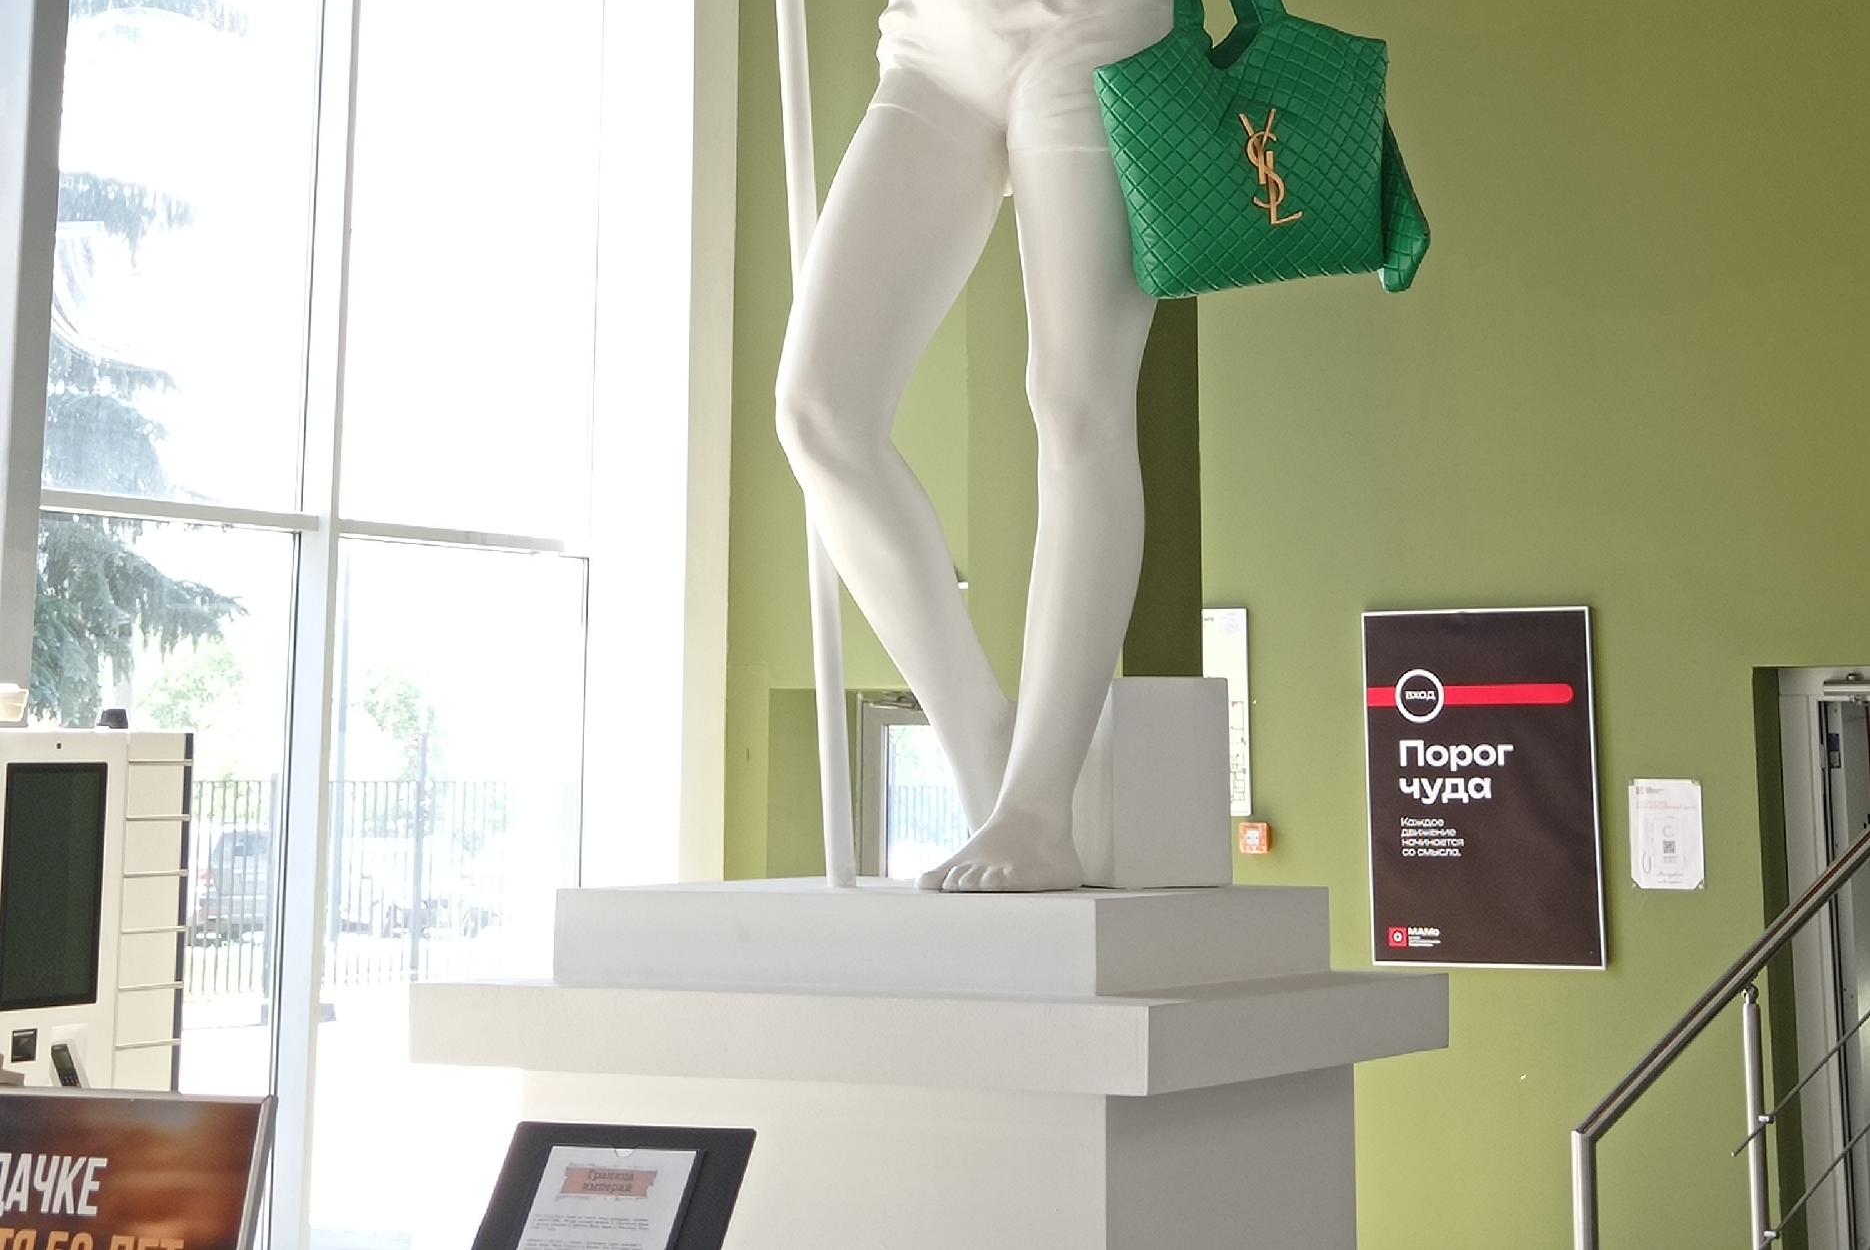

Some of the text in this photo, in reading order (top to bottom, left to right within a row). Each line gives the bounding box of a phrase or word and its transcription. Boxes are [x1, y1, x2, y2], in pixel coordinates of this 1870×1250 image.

[1238, 108, 1303, 225] YSL
[1399, 739, 1514, 772] Порог
[1399, 777, 1492, 804] чуда
[1400, 817, 1445, 827] Каждое
[1402, 848, 1416, 857] со
